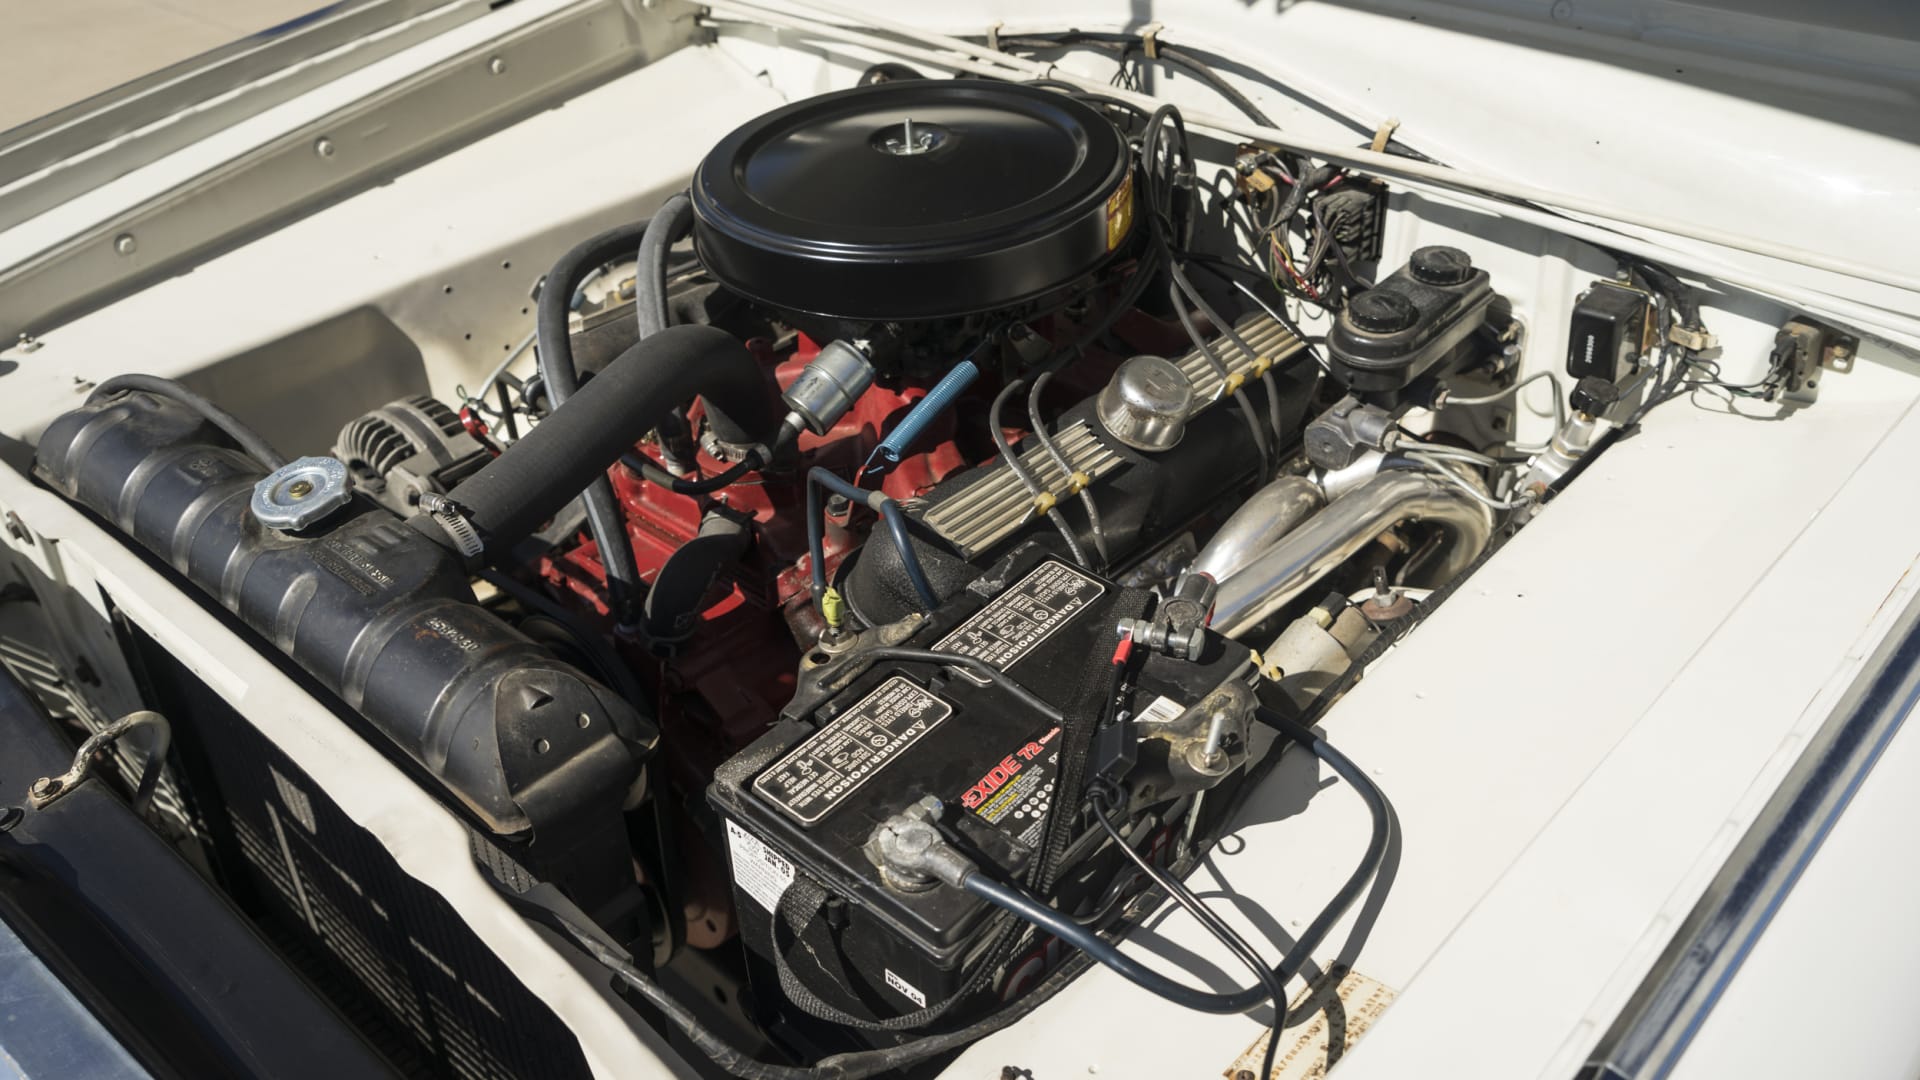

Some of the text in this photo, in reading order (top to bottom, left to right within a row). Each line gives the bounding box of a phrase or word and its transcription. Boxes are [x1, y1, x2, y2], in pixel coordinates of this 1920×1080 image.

[994, 603, 1074, 665] DANGER/POISON
[821, 727, 917, 800] DANGER/POISON
[961, 755, 1022, 808] EXIDE
[1016, 742, 1044, 760] 72
[763, 846, 790, 871] SHIPPED
[888, 976, 907, 993] NOV
